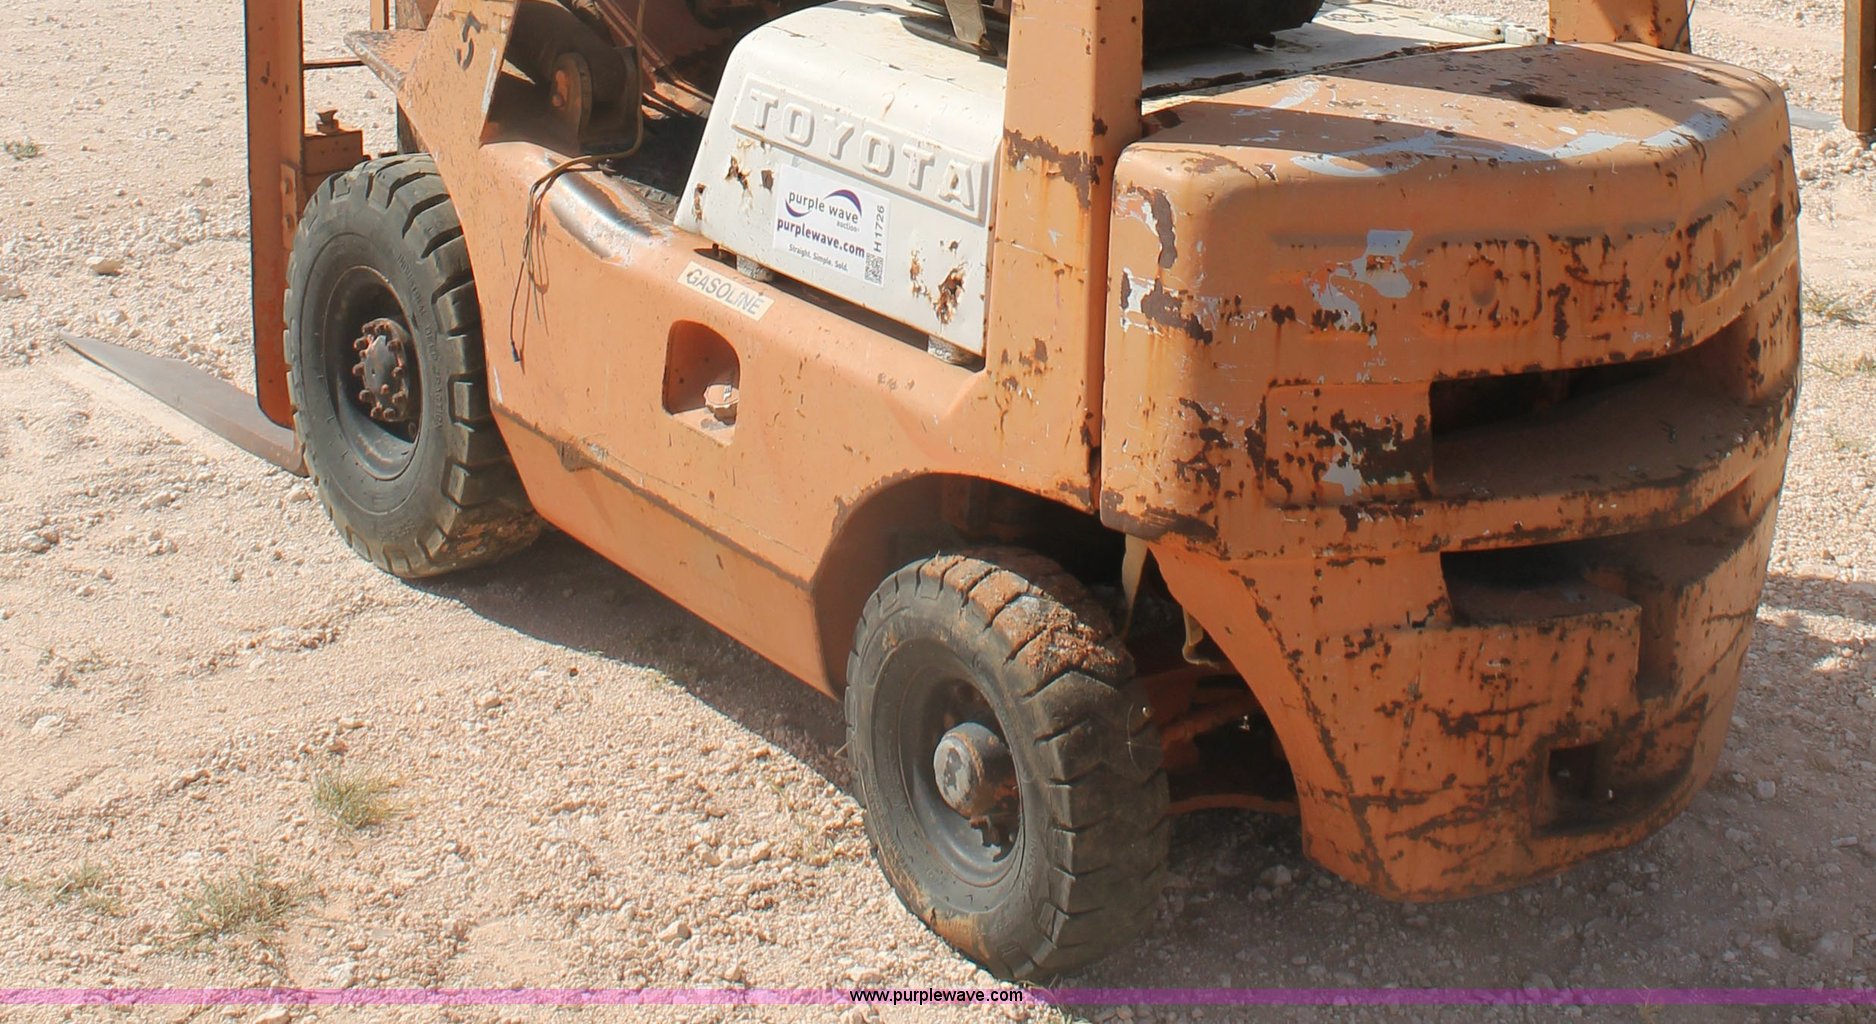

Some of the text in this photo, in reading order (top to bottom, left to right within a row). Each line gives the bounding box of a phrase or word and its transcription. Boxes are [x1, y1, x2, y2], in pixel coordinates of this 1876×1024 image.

[751, 88, 976, 212] TOYOTA
[788, 191, 859, 224] purple wave
[874, 205, 885, 238] 1726
[777, 217, 865, 259] purplewave.com
[788, 243, 849, 273] Straight. Simple. Sold.
[686, 268, 764, 316] GASOLINE
